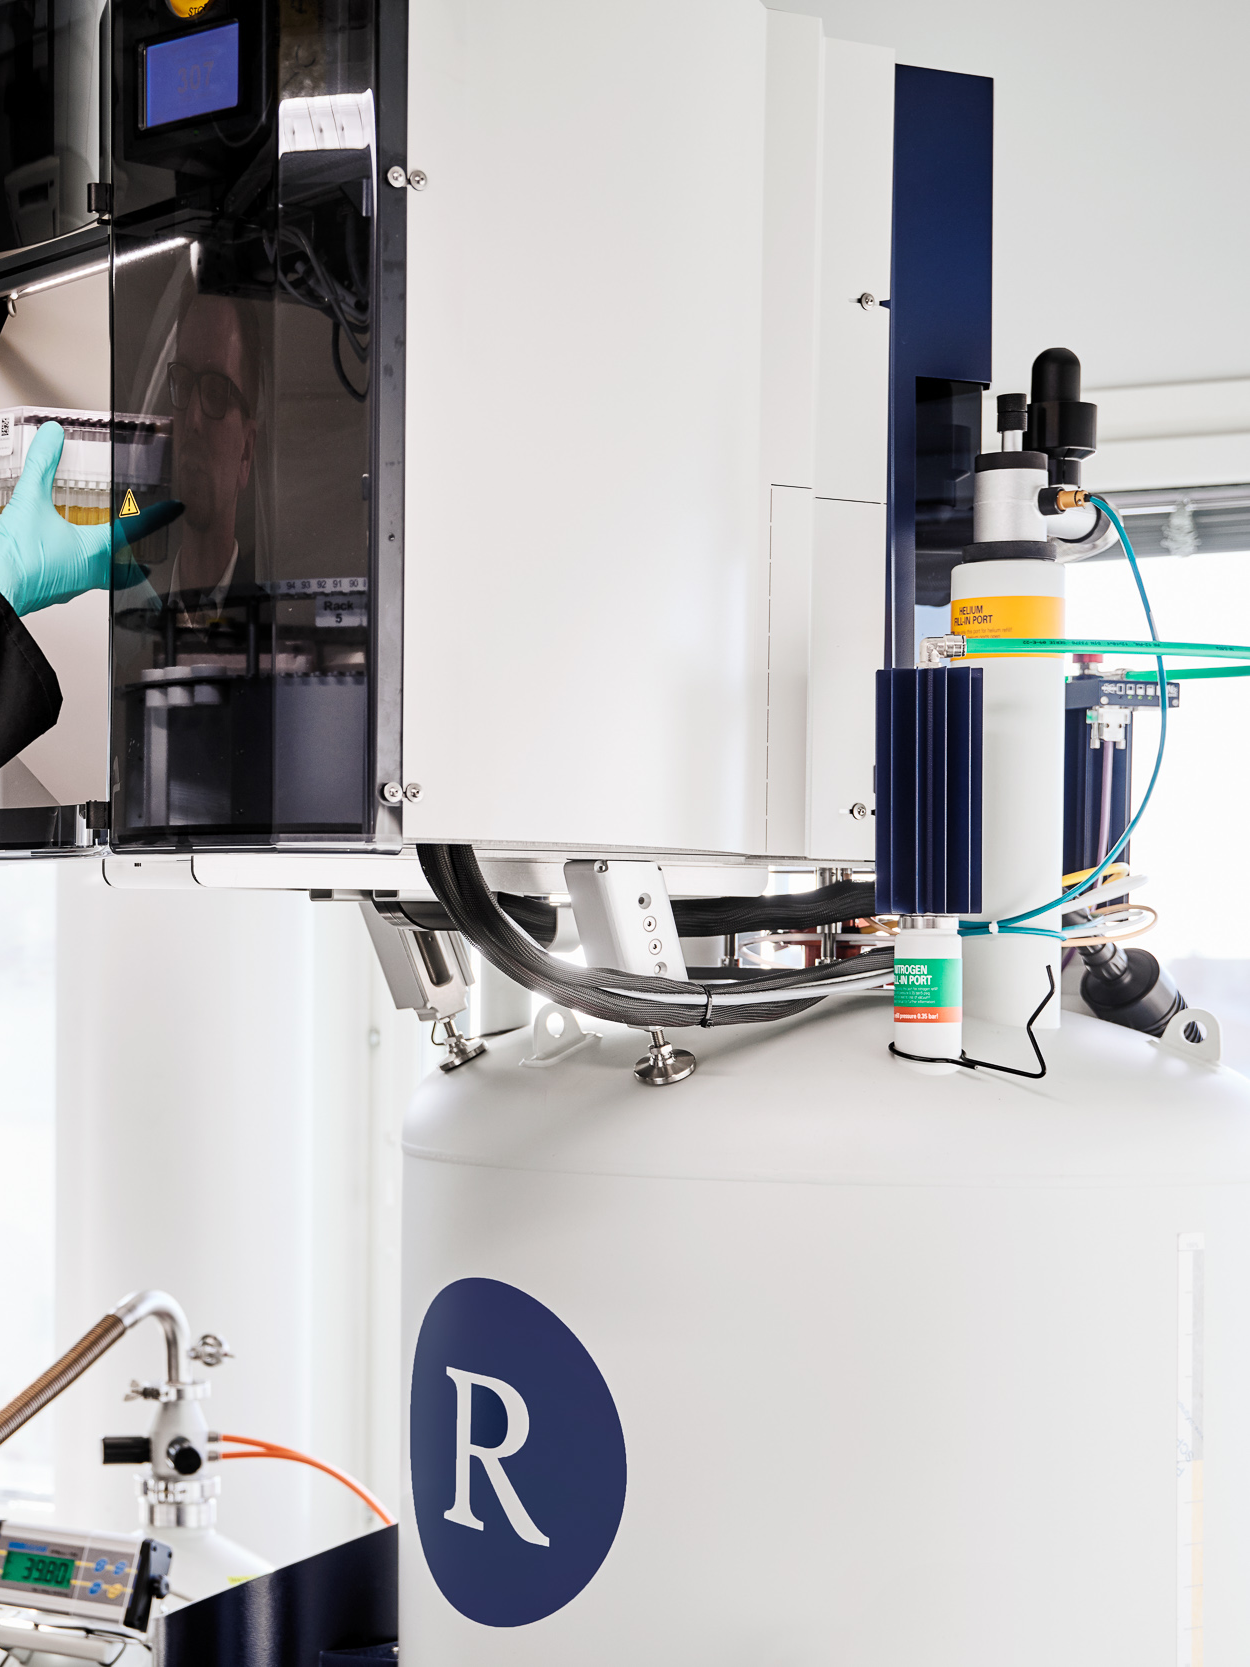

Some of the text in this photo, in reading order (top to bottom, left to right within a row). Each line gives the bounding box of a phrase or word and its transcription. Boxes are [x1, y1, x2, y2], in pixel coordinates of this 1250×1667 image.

[177, 60, 215, 94] 307
[286, 581, 296, 590] 94
[301, 580, 311, 589] 93
[316, 580, 327, 589] 92
[332, 579, 342, 588] 91
[349, 579, 359, 588] 90
[323, 601, 354, 611] Rack
[959, 605, 983, 615] HELIUM
[335, 613, 343, 624] 5
[973, 615, 993, 624] PORT
[909, 975, 932, 985] PORT
[444, 1366, 550, 1548] R
